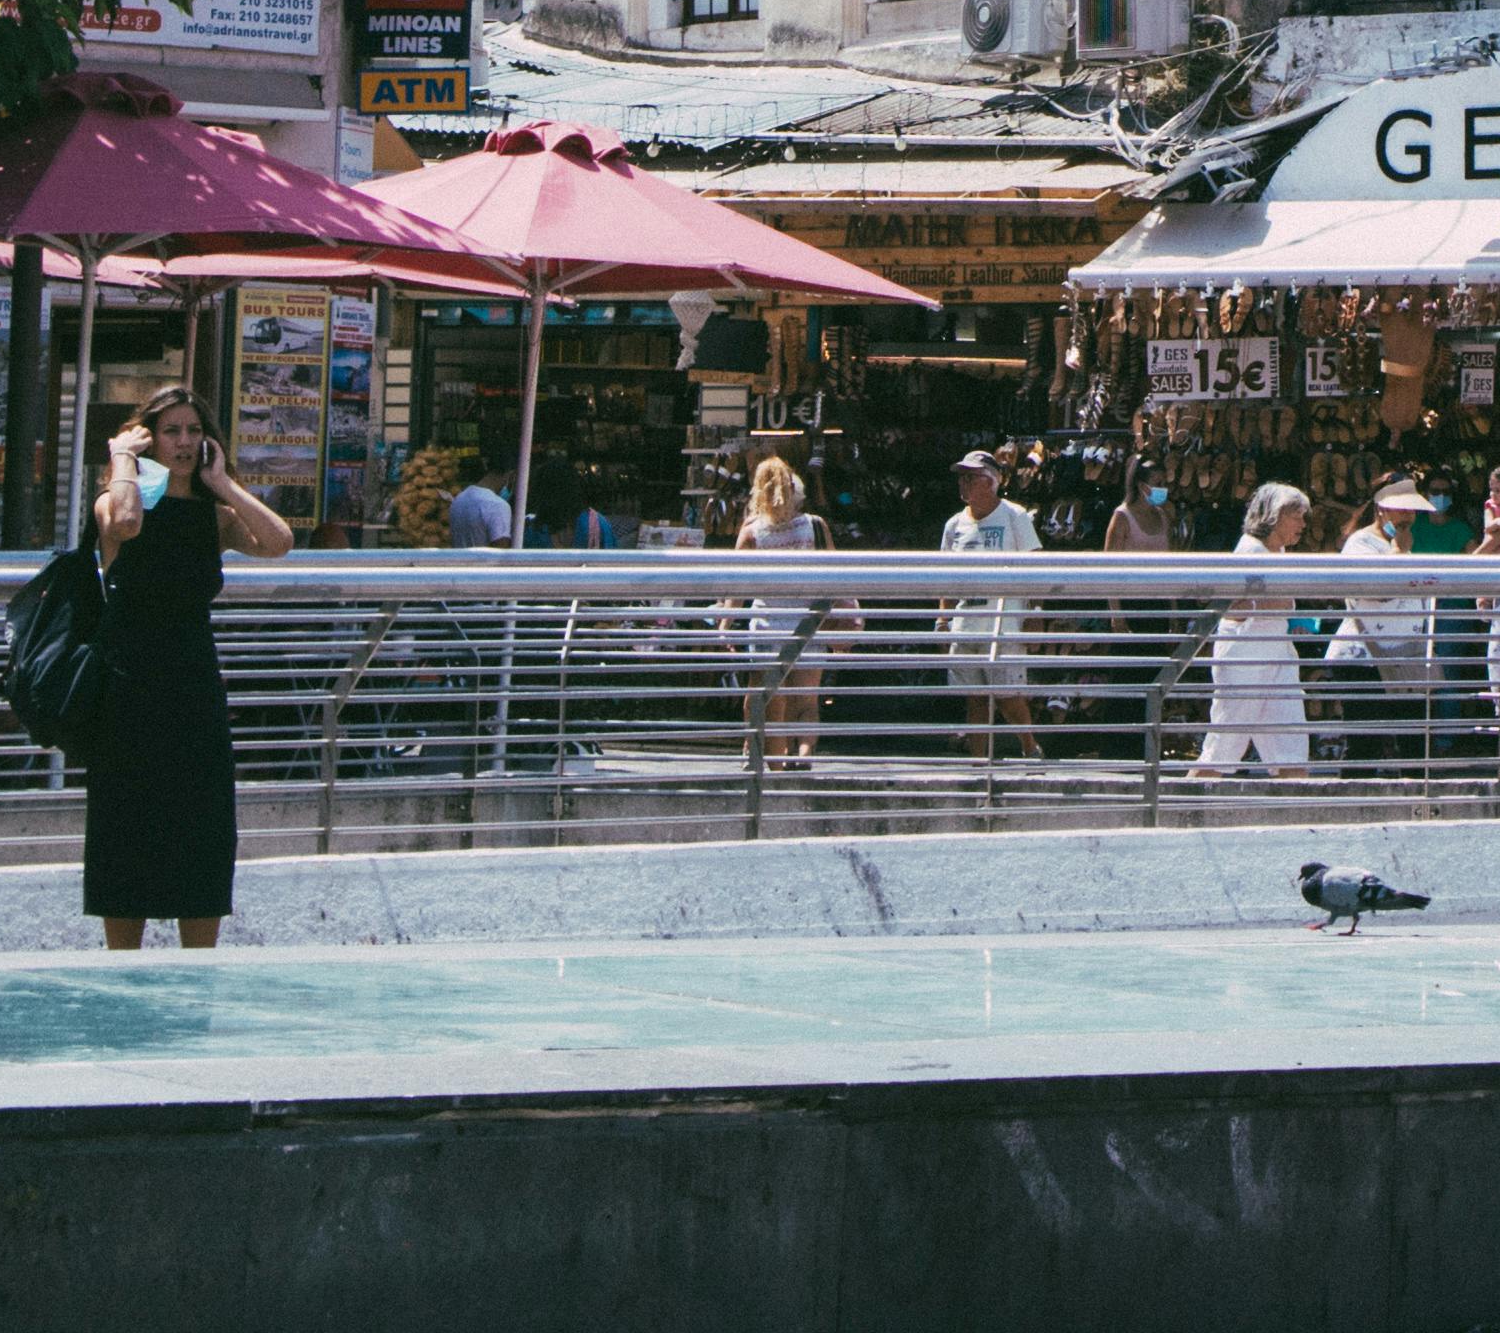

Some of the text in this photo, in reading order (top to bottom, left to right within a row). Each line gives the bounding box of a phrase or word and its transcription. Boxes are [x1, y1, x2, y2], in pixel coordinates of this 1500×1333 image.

[211, 8, 313, 26] Fax: 210 3248657
[368, 15, 461, 33] MINOAN
[183, 22, 313, 43] info@adrianostravel.gr
[383, 36, 442, 54] LINES
[371, 78, 455, 104] ATM
[963, 263, 1013, 285] Leather
[243, 304, 325, 318] BUS TOURS
[1164, 348, 1188, 361] GES
[1462, 353, 1493, 367] SALES
[1151, 364, 1188, 373] Sandals
[1193, 348, 1266, 393] 15€
[1151, 375, 1192, 392] SALES
[1473, 378, 1492, 391] GES
[250, 396, 273, 405] DAY
[278, 397, 321, 406] DELPHI
[750, 395, 787, 430] 10
[247, 435, 267, 444] DAY
